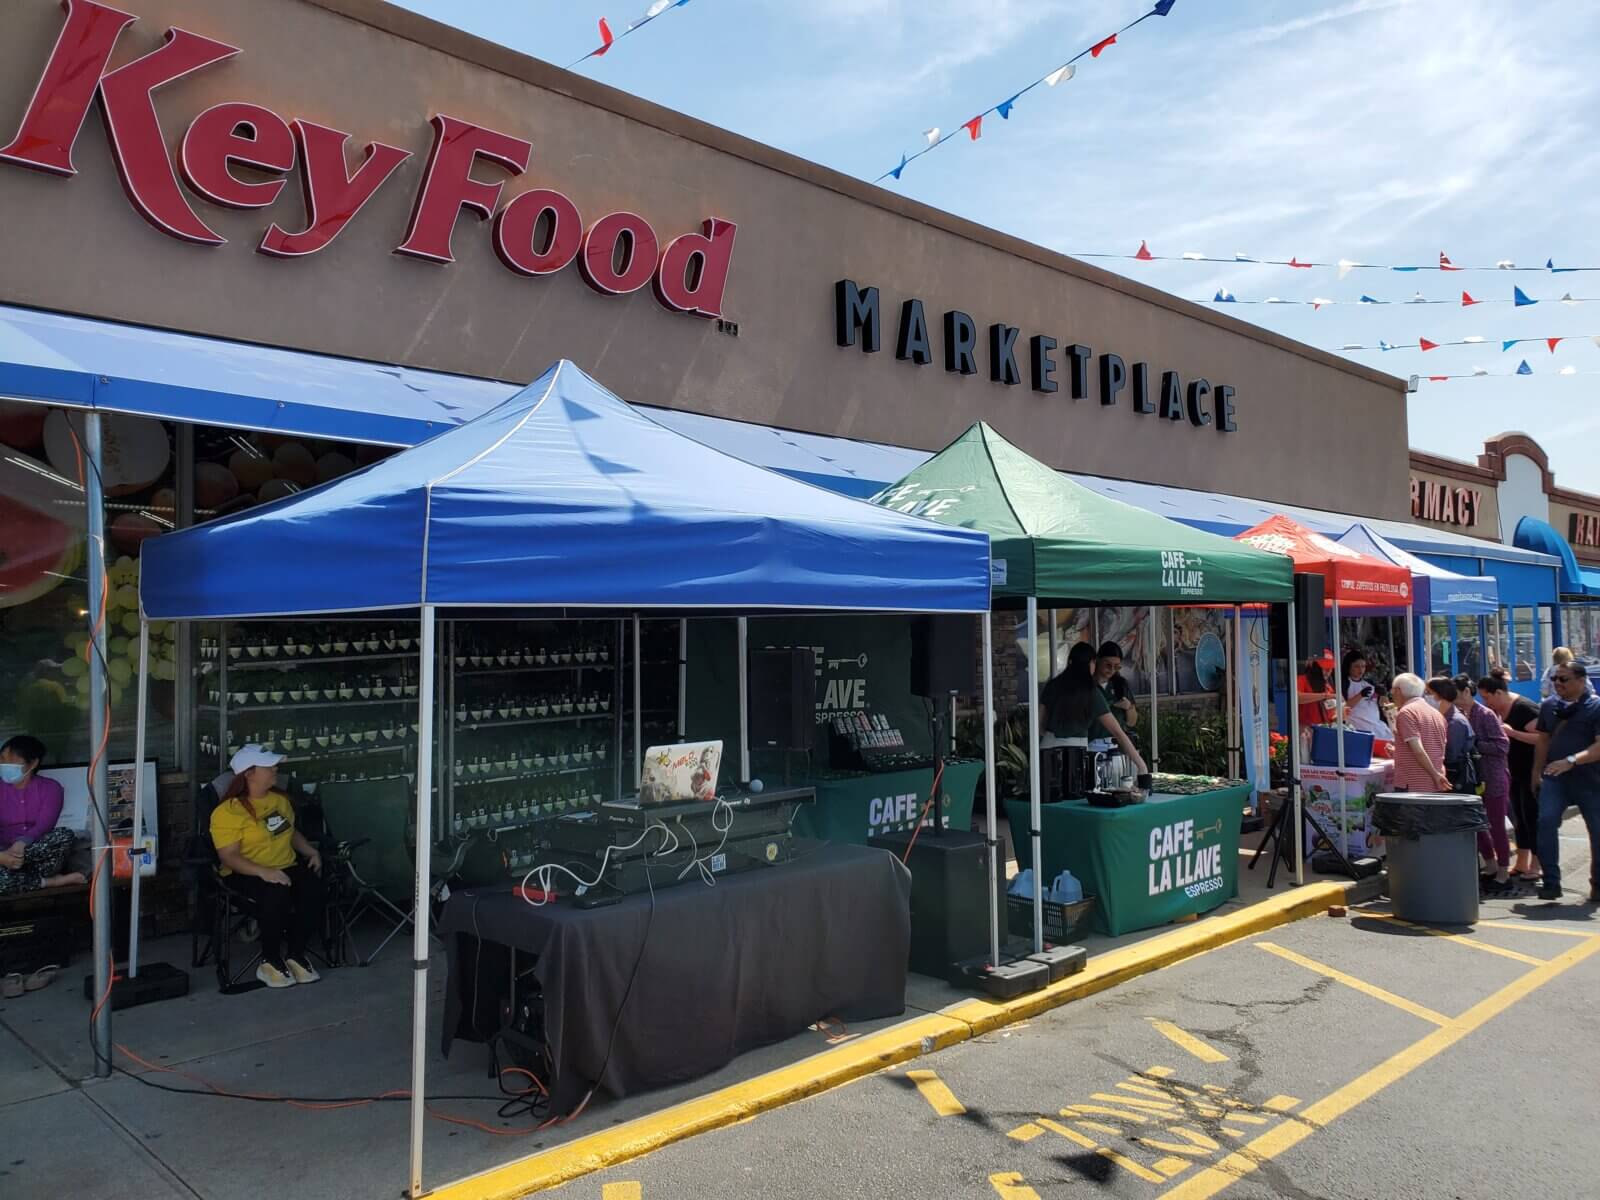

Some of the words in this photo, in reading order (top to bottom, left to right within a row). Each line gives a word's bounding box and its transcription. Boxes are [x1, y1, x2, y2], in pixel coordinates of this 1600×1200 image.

[392, 113, 738, 319] Food
[835, 278, 1238, 433] MARKETPLACE
[1160, 551, 1186, 569] CAFE
[1162, 569, 1175, 587] LA
[1176, 570, 1204, 588] LLAVE
[815, 679, 866, 710] AVE
[869, 793, 917, 827] CAFE
[1149, 819, 1194, 861] CAFE
[1149, 859, 1173, 896] LA
[1175, 844, 1222, 888] LLAVE
[1184, 876, 1224, 898] ESPRESSO
